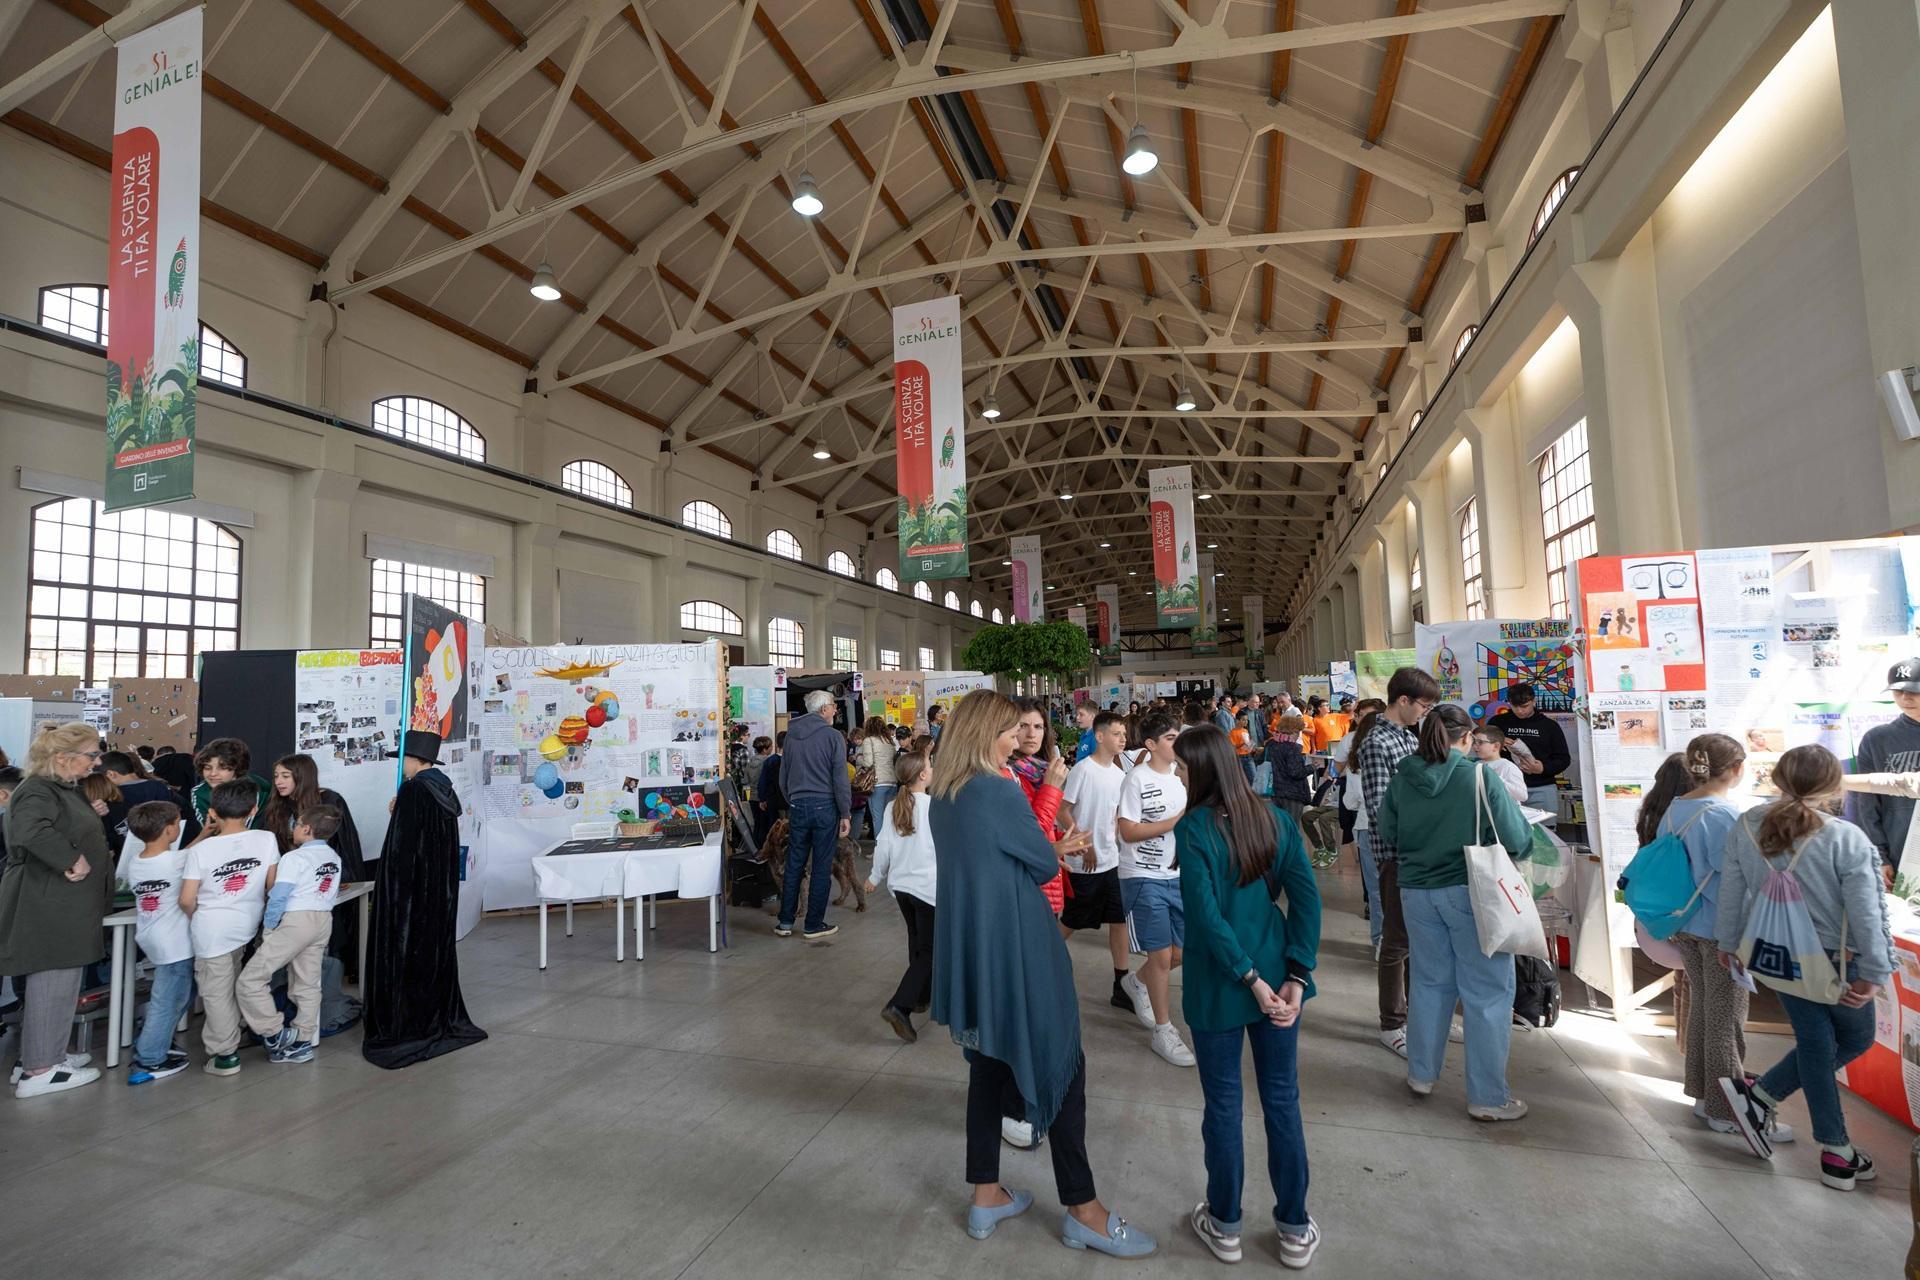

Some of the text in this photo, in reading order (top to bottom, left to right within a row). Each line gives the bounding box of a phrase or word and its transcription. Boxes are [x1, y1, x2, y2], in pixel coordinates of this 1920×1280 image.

[125, 60, 198, 104] GENIALE!
[121, 157, 135, 265] LA SCIENZA
[135, 152, 151, 278] TI FA VOLARE
[899, 326, 957, 345] GENIALE!
[902, 377, 912, 440] LA SCIENZA
[913, 375, 925, 448] TI FA VOLARE
[492, 648, 550, 669] SCUOLA
[1508, 727, 1539, 735] NOTHING
